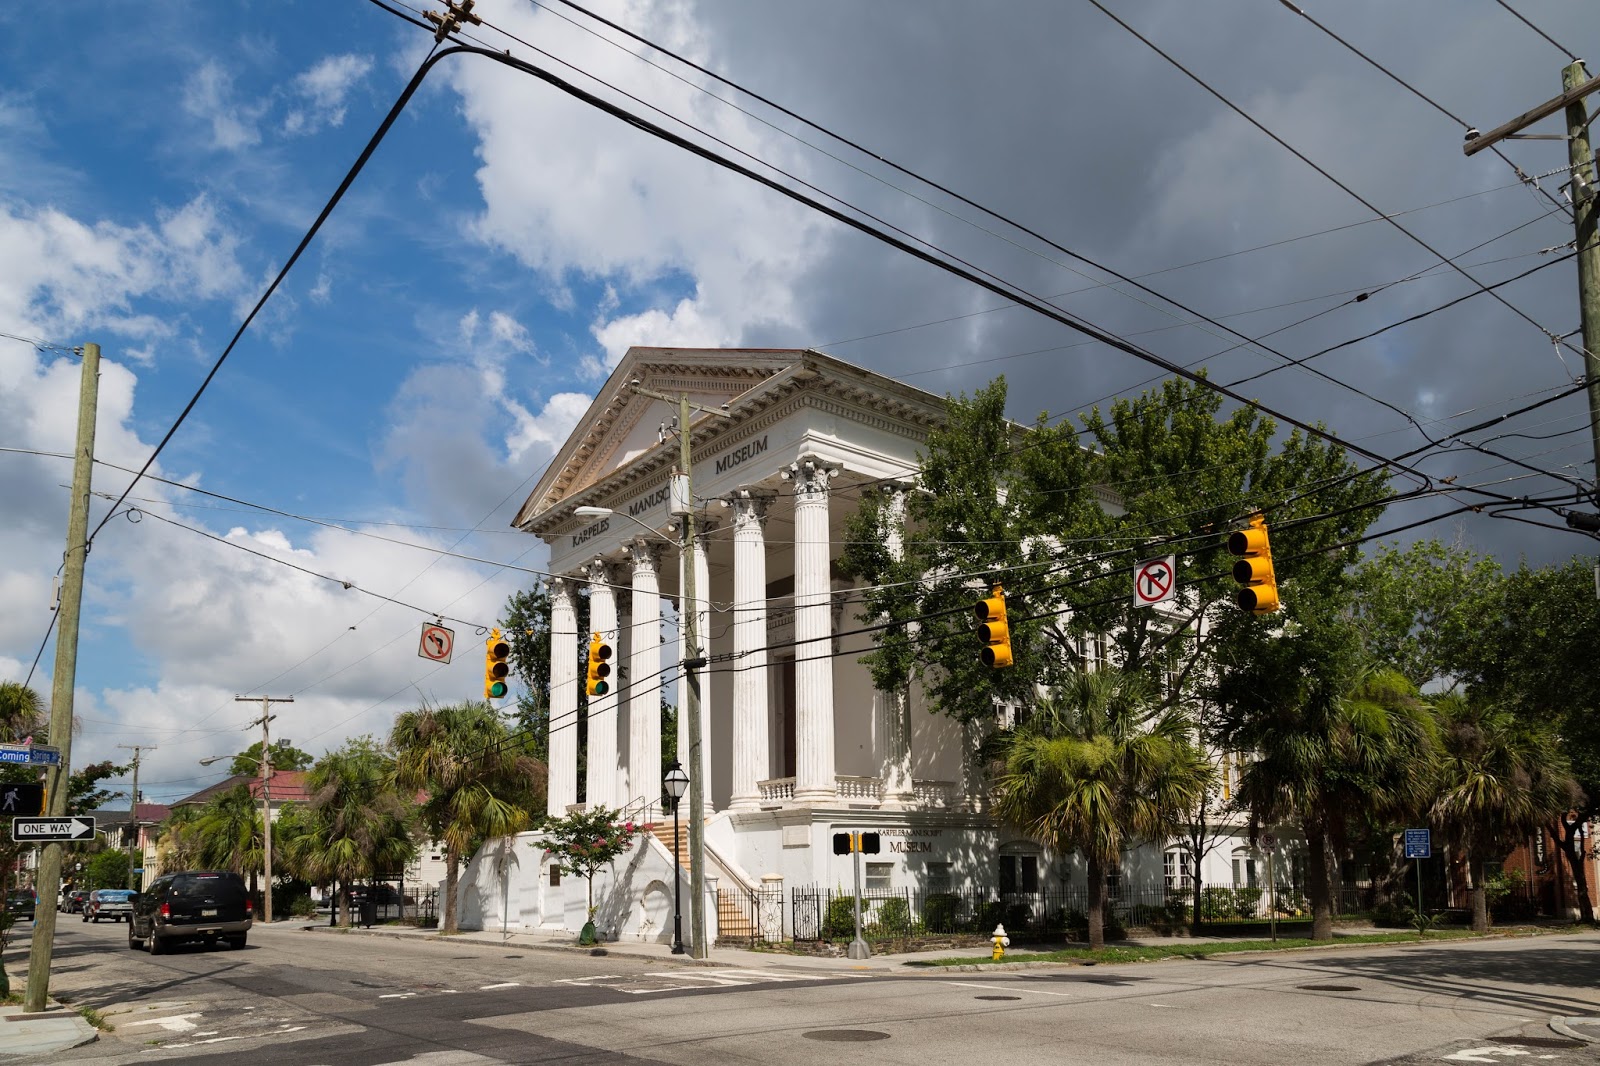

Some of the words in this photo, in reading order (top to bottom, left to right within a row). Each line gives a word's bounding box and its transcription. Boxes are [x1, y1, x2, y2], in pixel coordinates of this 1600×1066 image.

[572, 517, 610, 547] KARPELES
[629, 486, 671, 516] MANUSC
[715, 435, 768, 474] MUSEUM
[32, 750, 50, 763] Spring
[23, 824, 46, 834] ONE
[50, 823, 72, 833] WAY
[878, 829, 905, 837] KARPELES
[906, 829, 942, 837] MANUSCRIPT
[889, 841, 931, 853] MUSEUM
